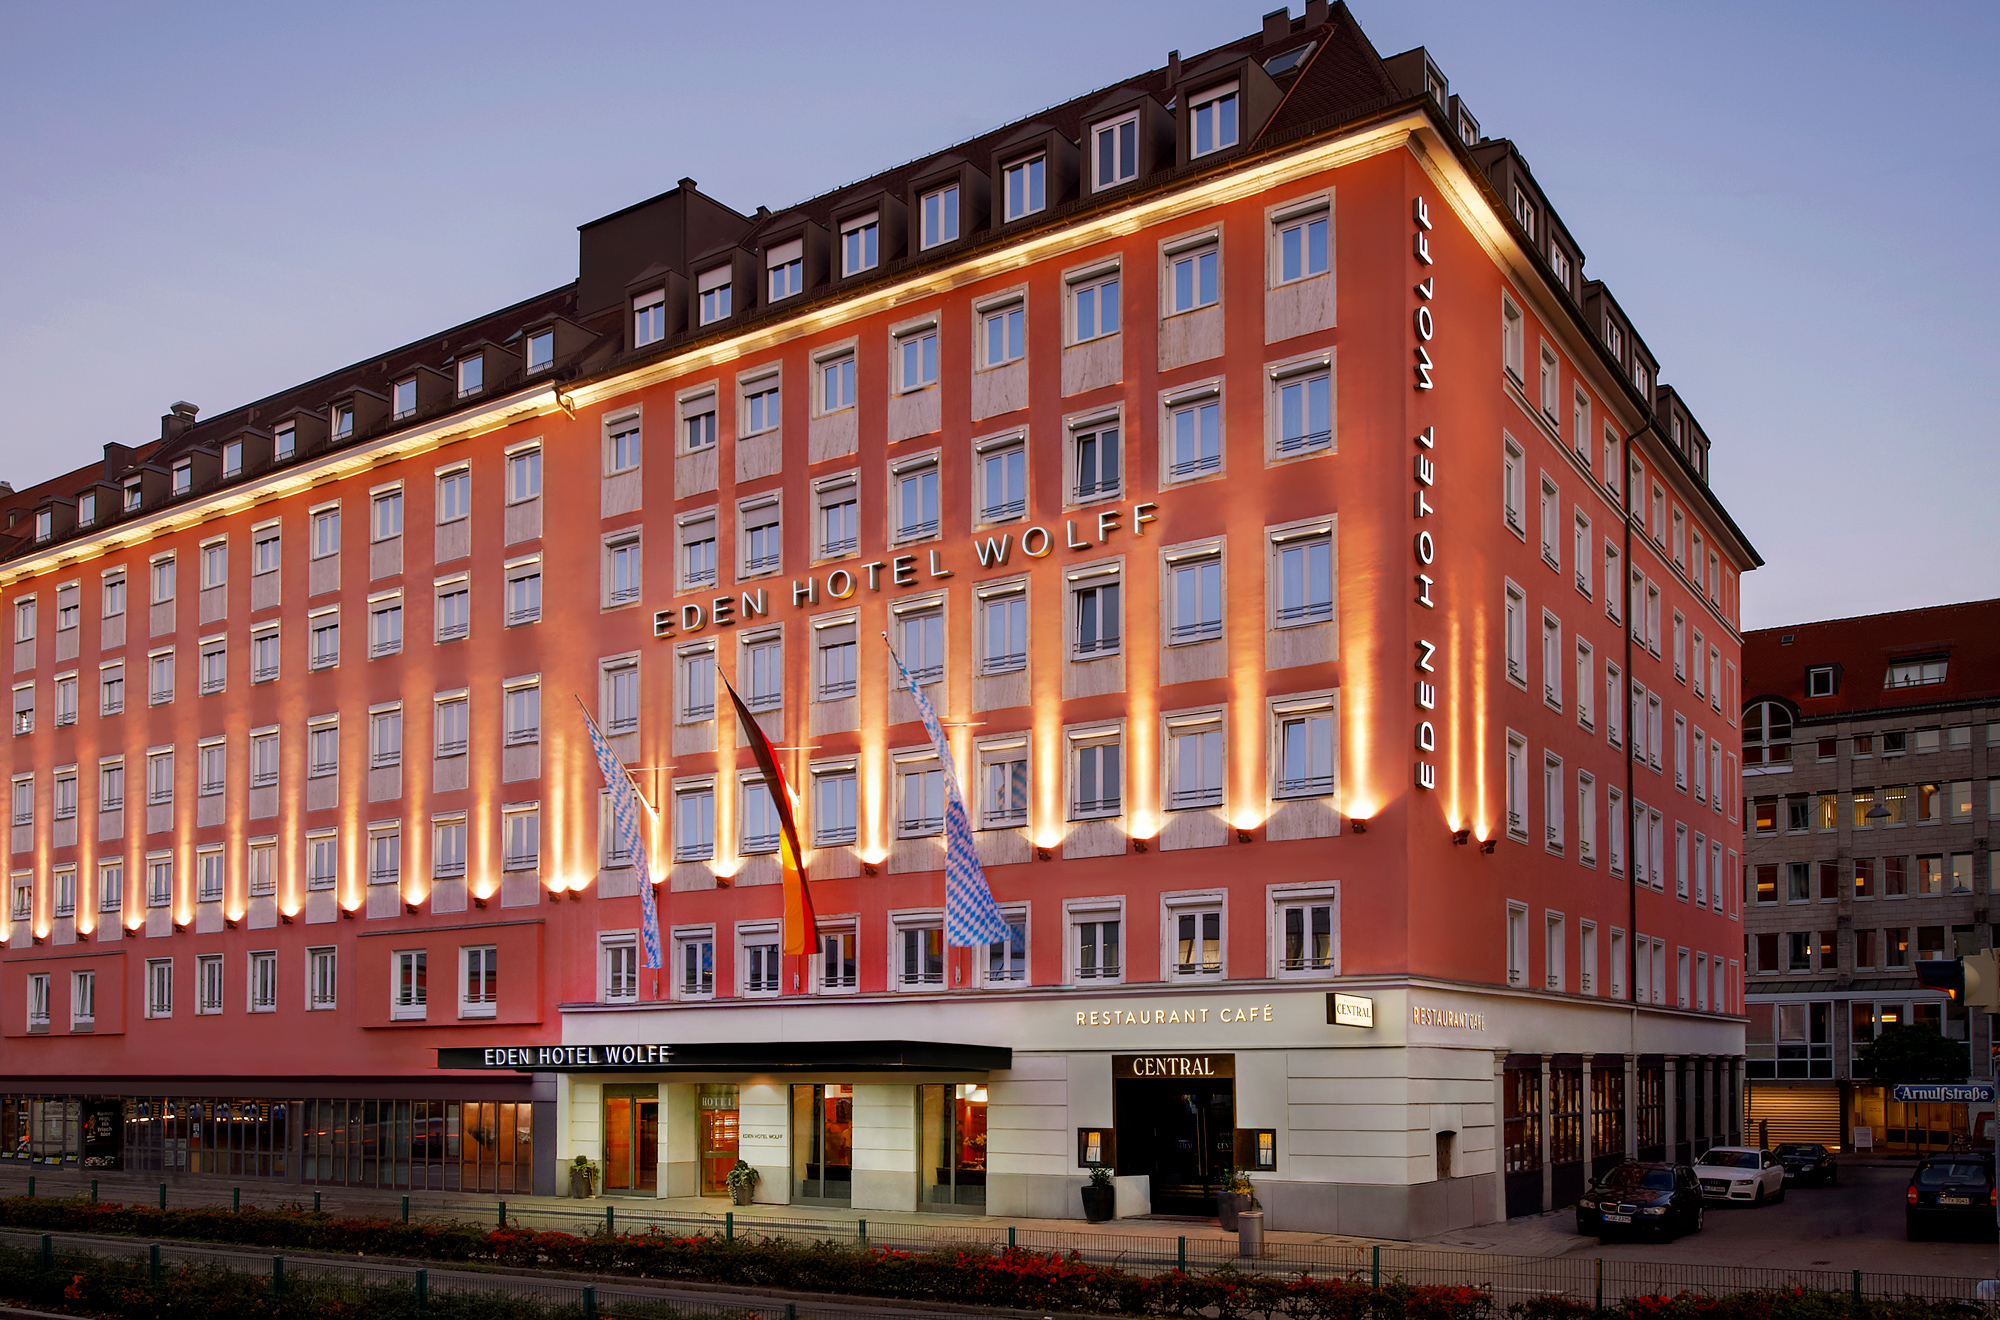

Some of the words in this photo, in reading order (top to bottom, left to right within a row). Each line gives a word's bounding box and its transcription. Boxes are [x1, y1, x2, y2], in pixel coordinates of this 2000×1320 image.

[1413, 195, 1434, 392] WOLFF
[1414, 425, 1435, 610] HOTEL
[653, 588, 768, 639] EDEN
[792, 549, 955, 609] HOTEL
[973, 503, 1158, 568] WOLFF
[1414, 638, 1436, 791] EDEN
[1076, 1008, 1210, 1026] RESTAURANT
[1219, 1003, 1274, 1023] CAFÉ
[1336, 1003, 1371, 1018] CENTRAL
[1412, 1006, 1468, 1029] RESTAURANT
[1468, 1012, 1485, 1032] CAFÉ
[484, 1048, 530, 1065] EDEN
[539, 1047, 599, 1065] HOTEL
[605, 1045, 671, 1064] WOLFF
[1133, 1057, 1215, 1076] CENTRAL
[702, 1097, 735, 1107] HOTEL
[1902, 1087, 1989, 1102] Arnulfstraße
